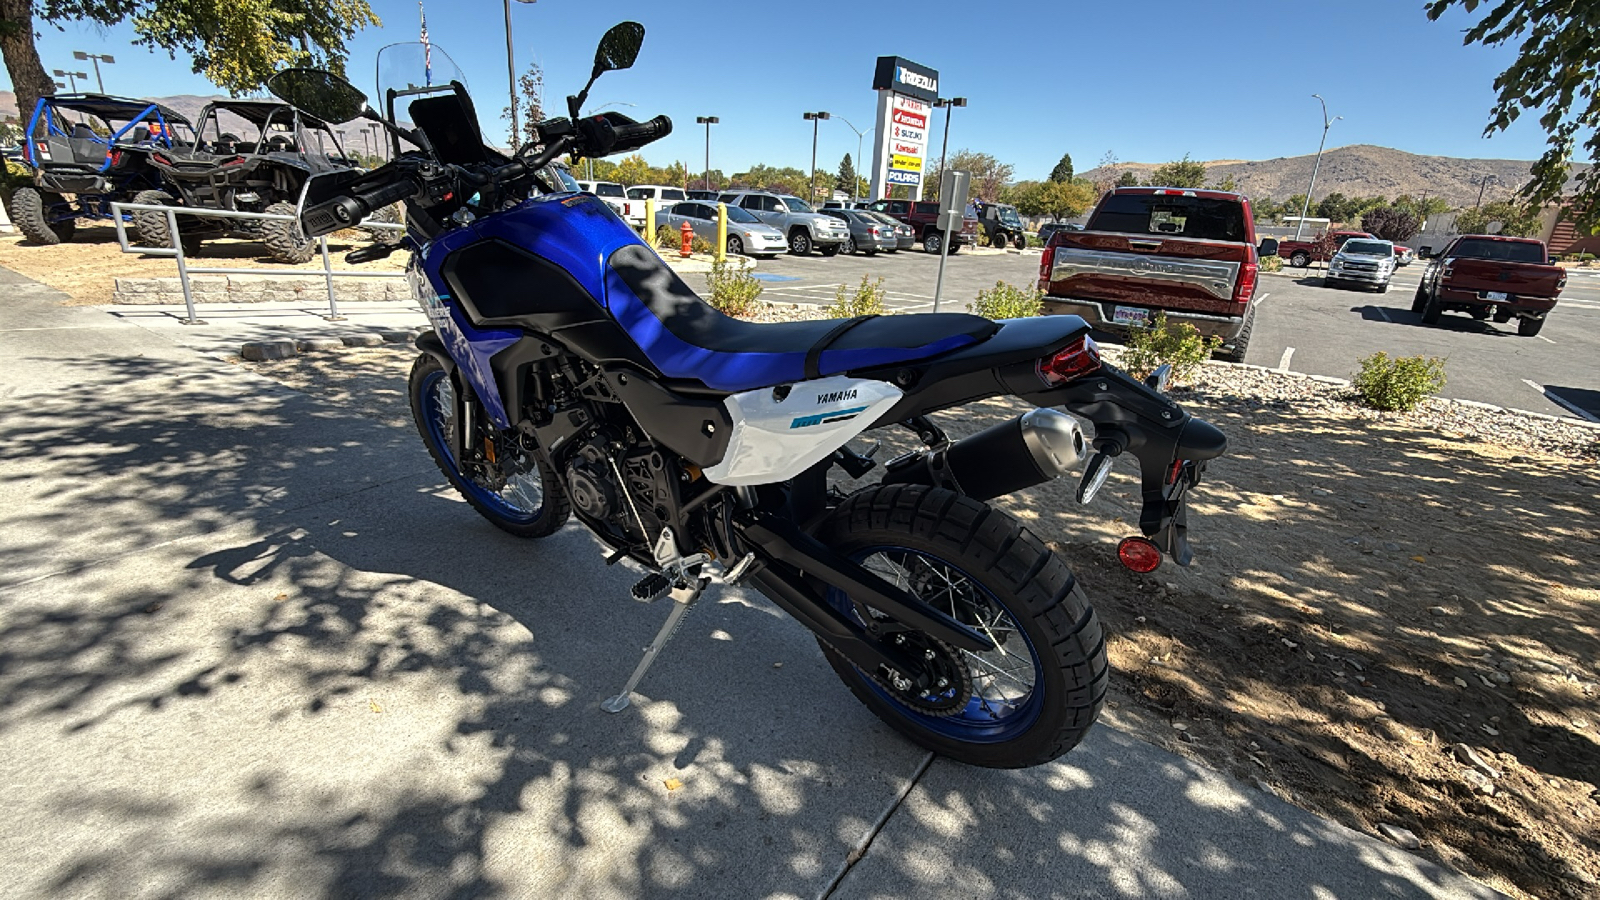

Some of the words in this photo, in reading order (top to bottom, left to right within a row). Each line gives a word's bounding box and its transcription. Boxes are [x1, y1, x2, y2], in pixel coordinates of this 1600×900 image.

[901, 115, 923, 128] HONDA
[901, 129, 922, 141] SUZUKI
[895, 143, 919, 154] Kawasaki
[888, 171, 919, 183] POLARIS
[817, 389, 858, 404] YAMAHA
